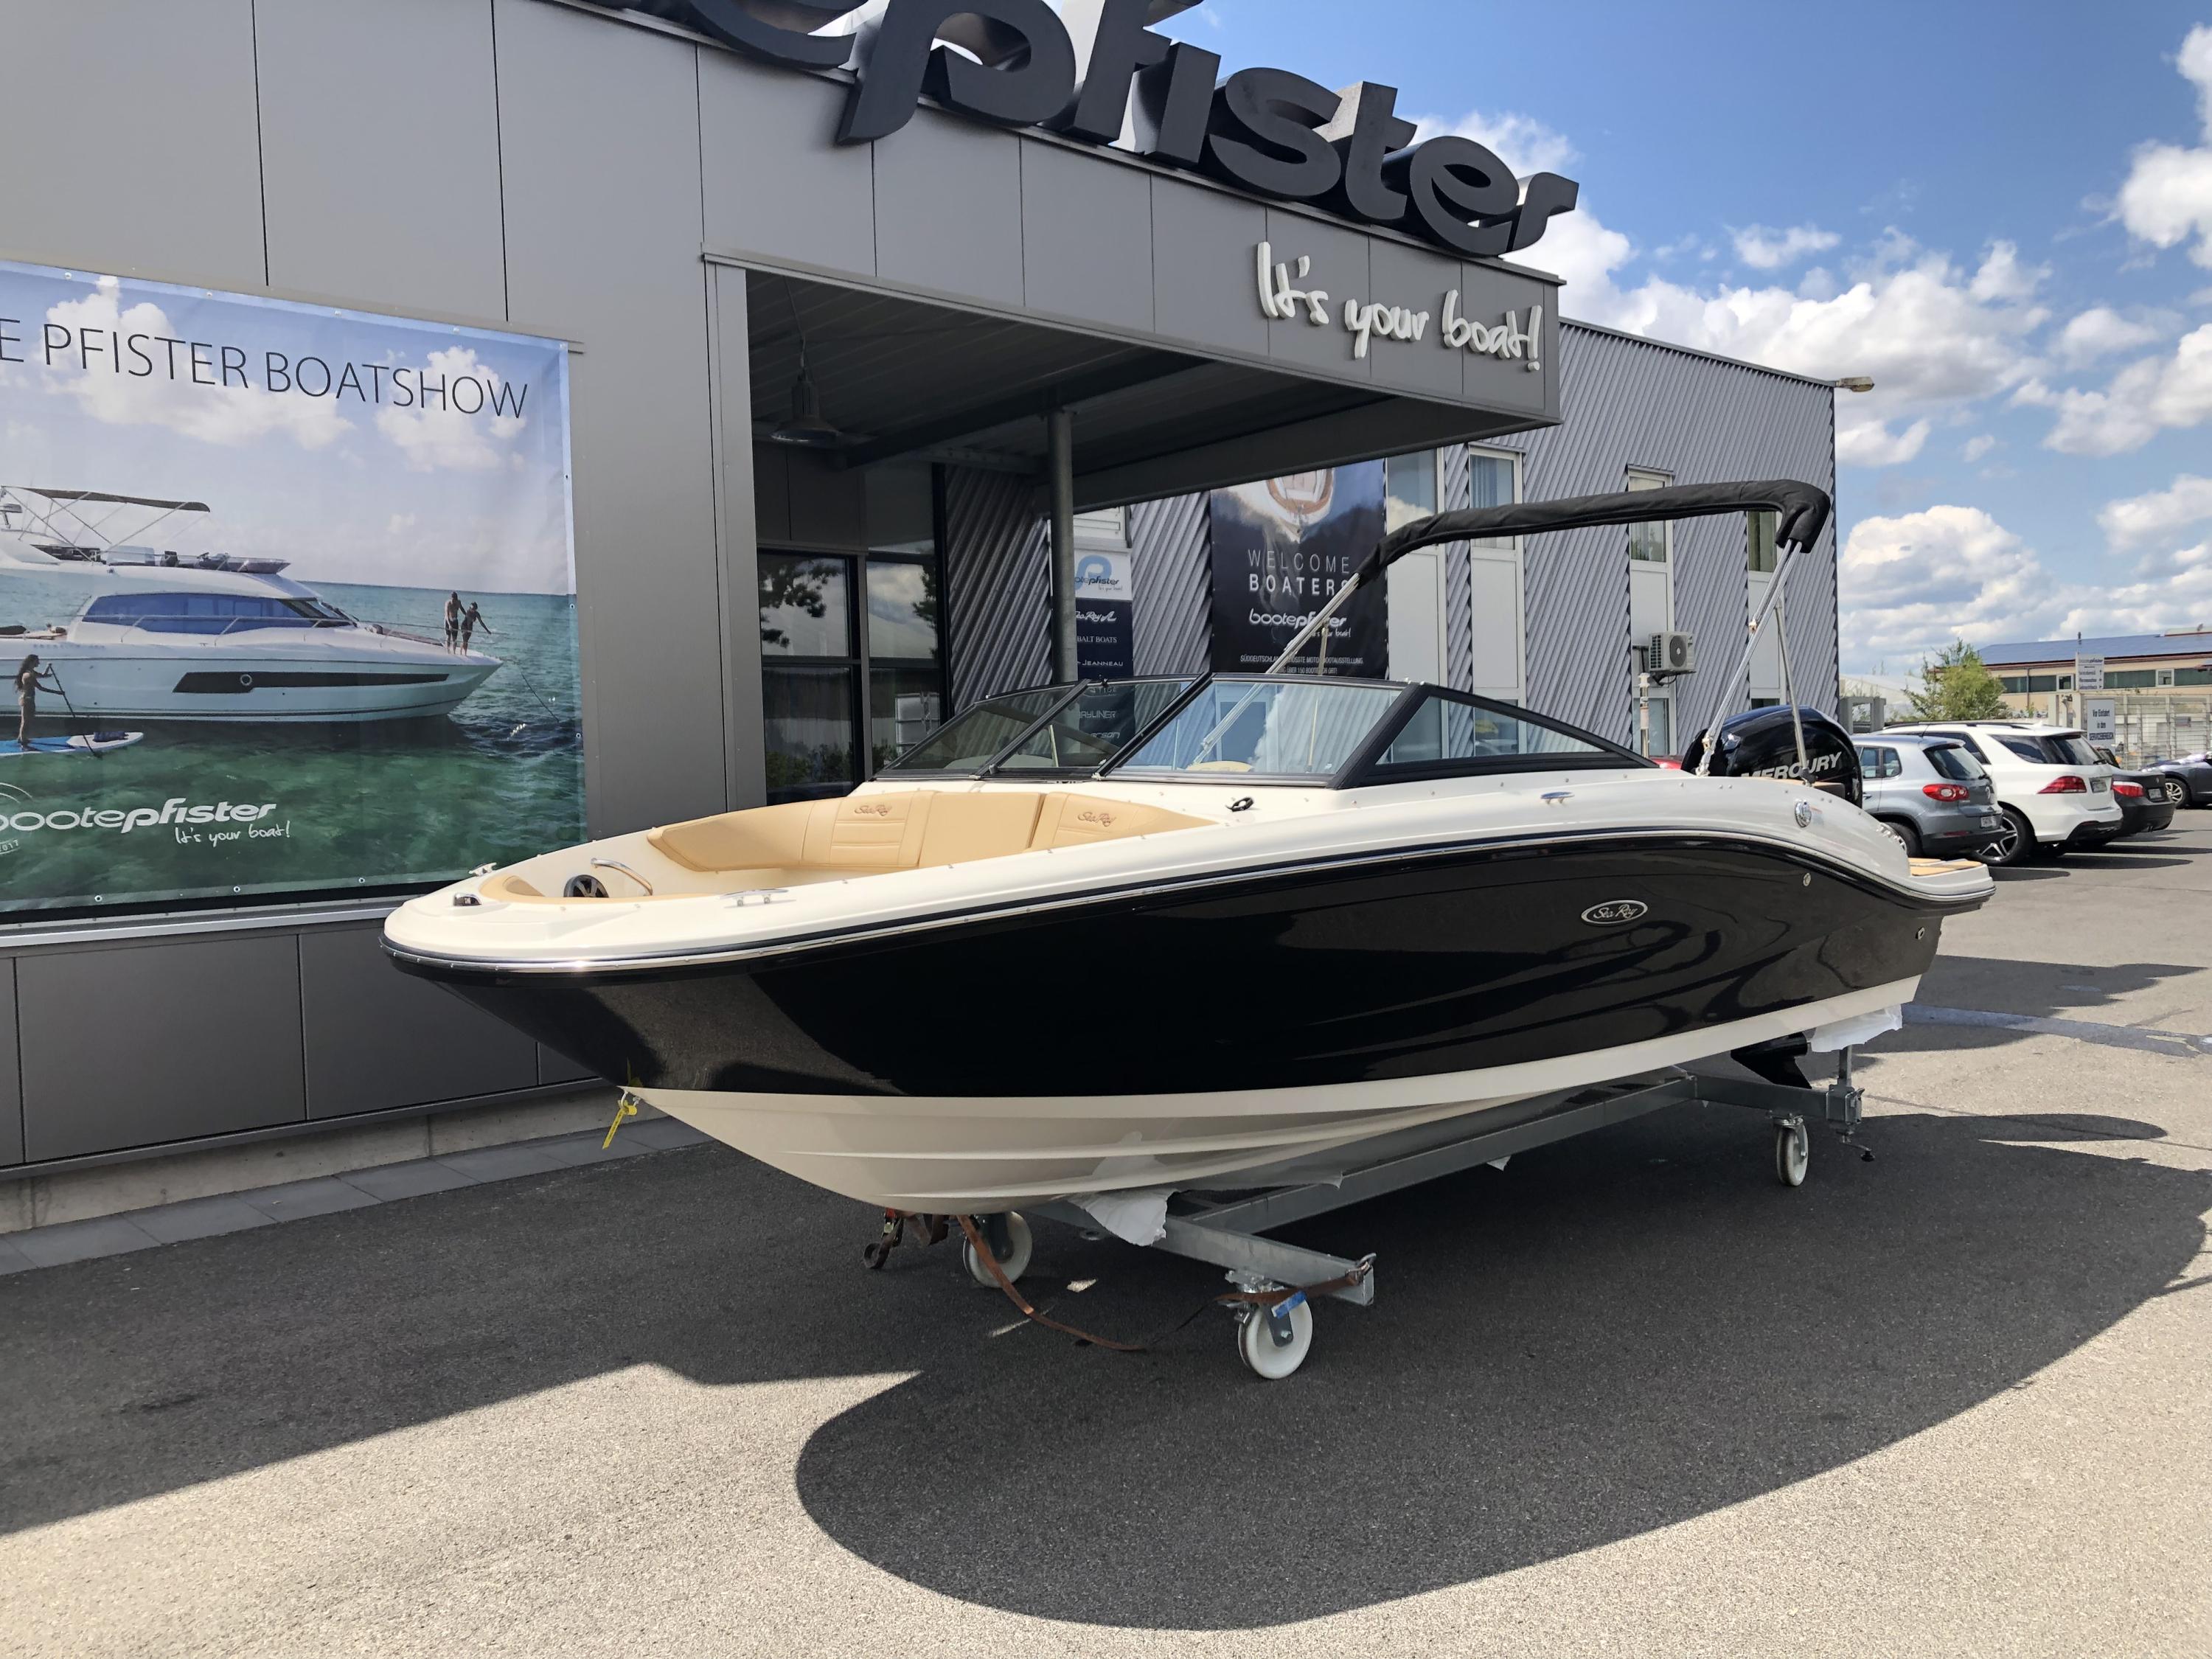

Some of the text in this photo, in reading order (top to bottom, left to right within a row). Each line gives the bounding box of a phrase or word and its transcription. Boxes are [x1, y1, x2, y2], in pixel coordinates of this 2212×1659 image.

[1256, 241, 1543, 371] It's your boat!
[44, 323, 248, 389] PFISTER
[266, 352, 528, 419] BOATSHOW
[1248, 549, 1350, 574] WELCOME
[1074, 575, 1120, 585] otepfister
[1249, 608, 1347, 630] bootepfer
[1096, 636, 1118, 644] BOATS
[1079, 710, 1116, 719] AYLINER
[0, 797, 277, 834] ootepfister
[174, 820, 291, 848] It's your boat!
[1593, 904, 1638, 919] Sea Ray
